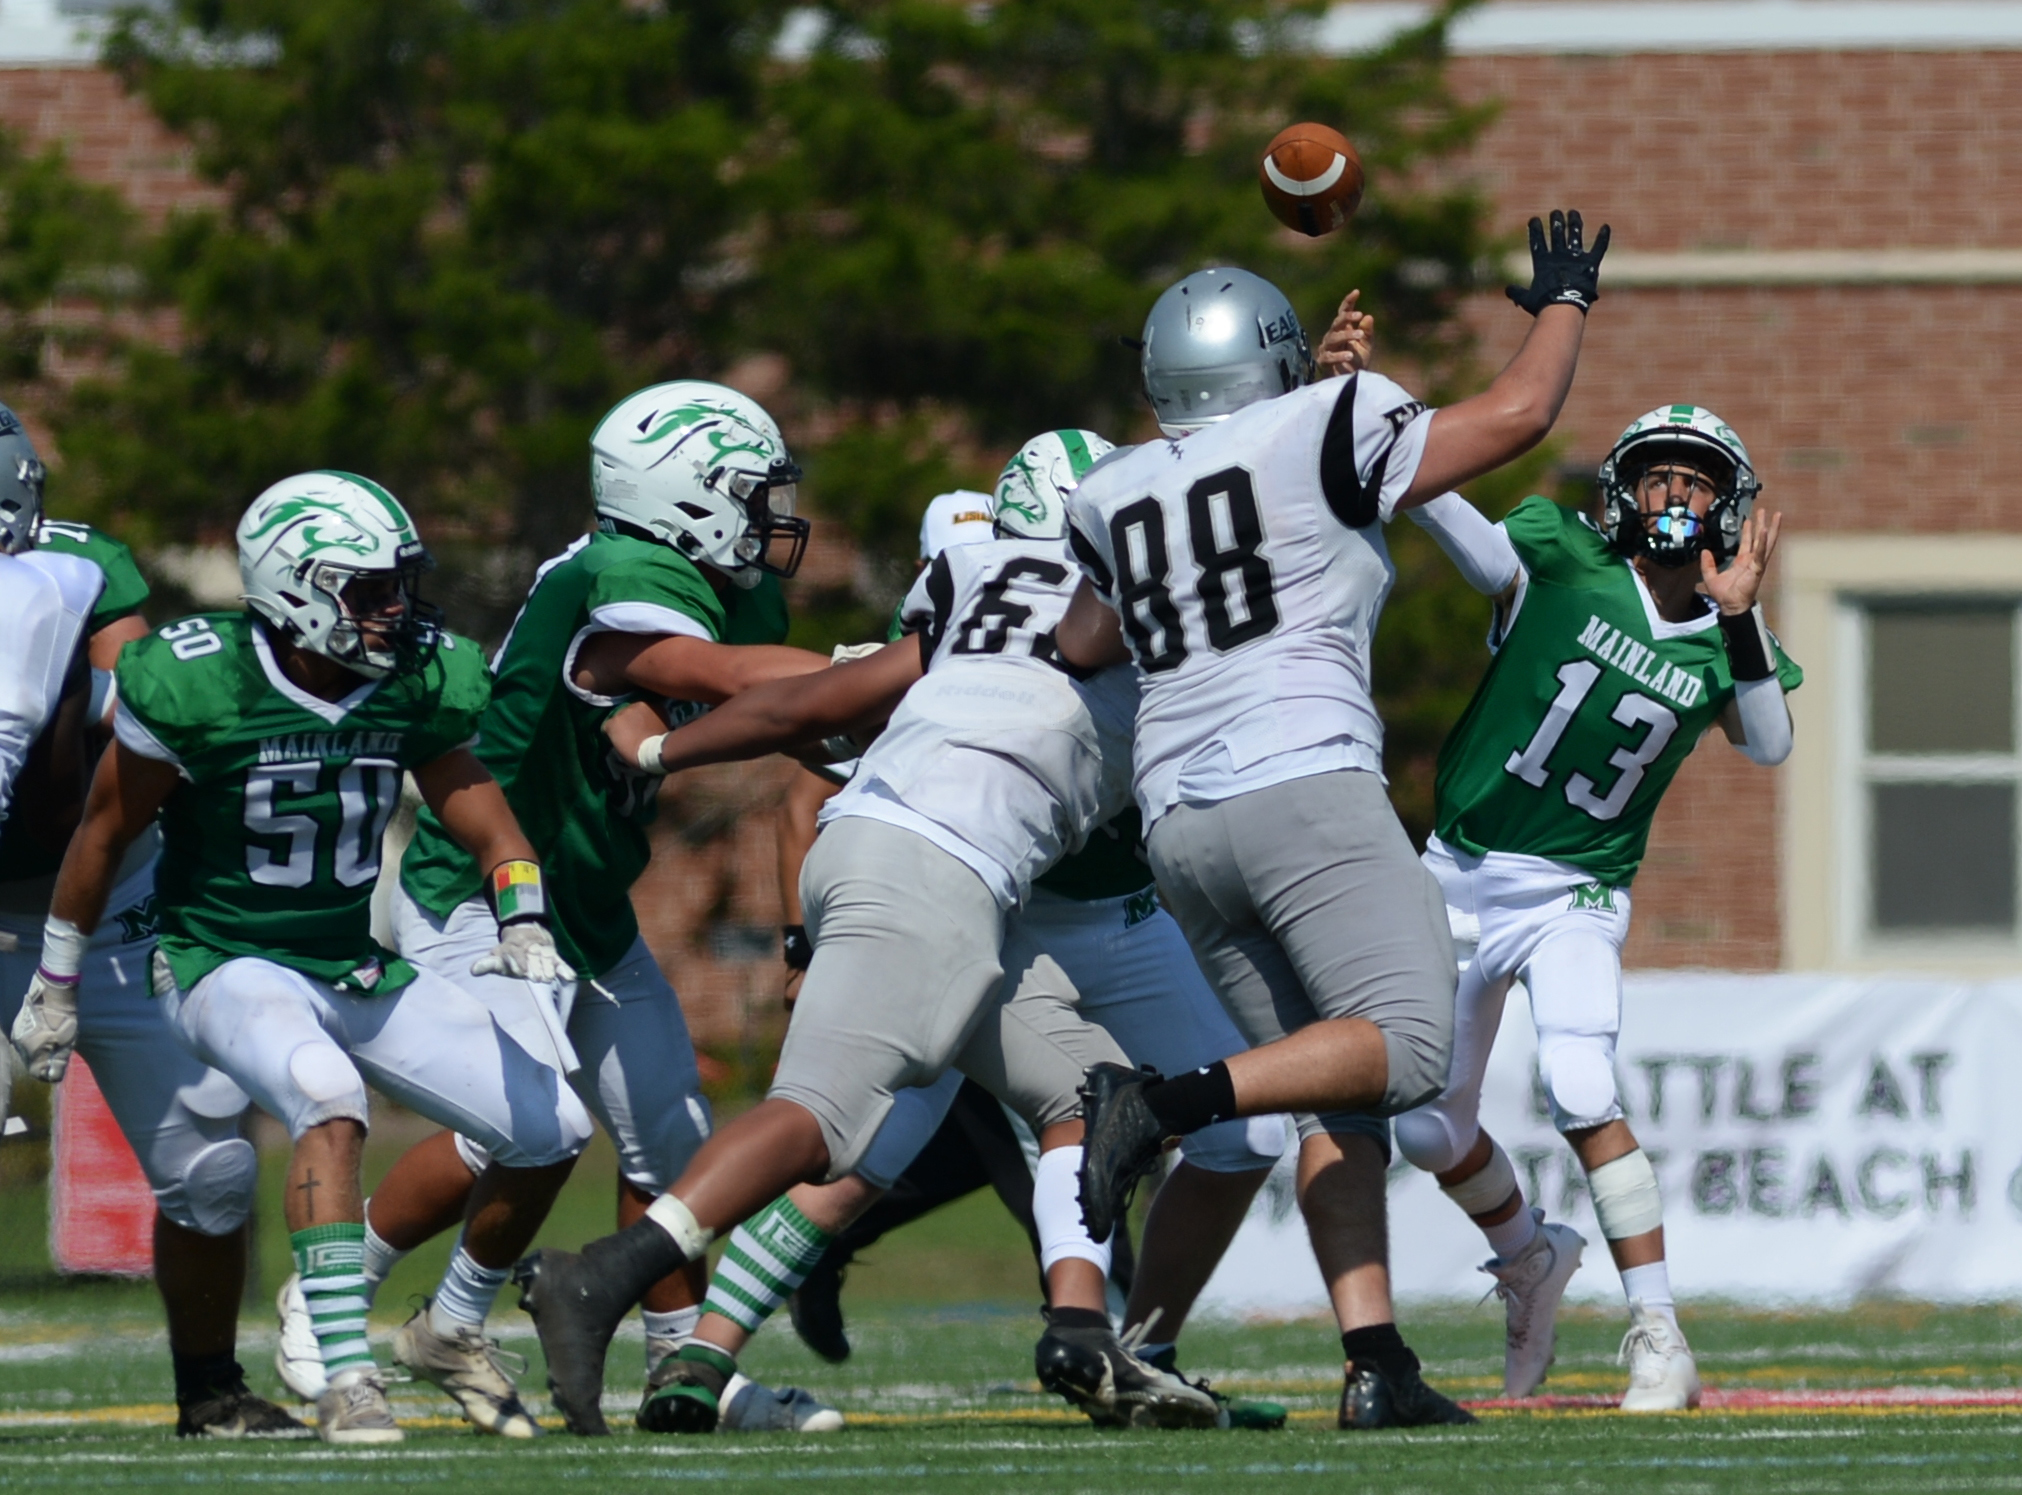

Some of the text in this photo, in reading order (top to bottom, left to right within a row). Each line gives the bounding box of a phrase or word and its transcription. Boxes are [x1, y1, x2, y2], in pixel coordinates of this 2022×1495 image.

[1108, 462, 1284, 678] 88
[159, 618, 222, 660] 50
[950, 556, 1102, 683] 6
[1576, 614, 1702, 708] MAINLAND
[258, 732, 403, 763] MAINLAND
[1504, 659, 1679, 821] 13
[244, 757, 399, 888] 50
[1123, 884, 1160, 929] M
[1567, 881, 1618, 915] M
[1857, 1051, 1952, 1121] AT
[1692, 1145, 1978, 1219] BEACH
